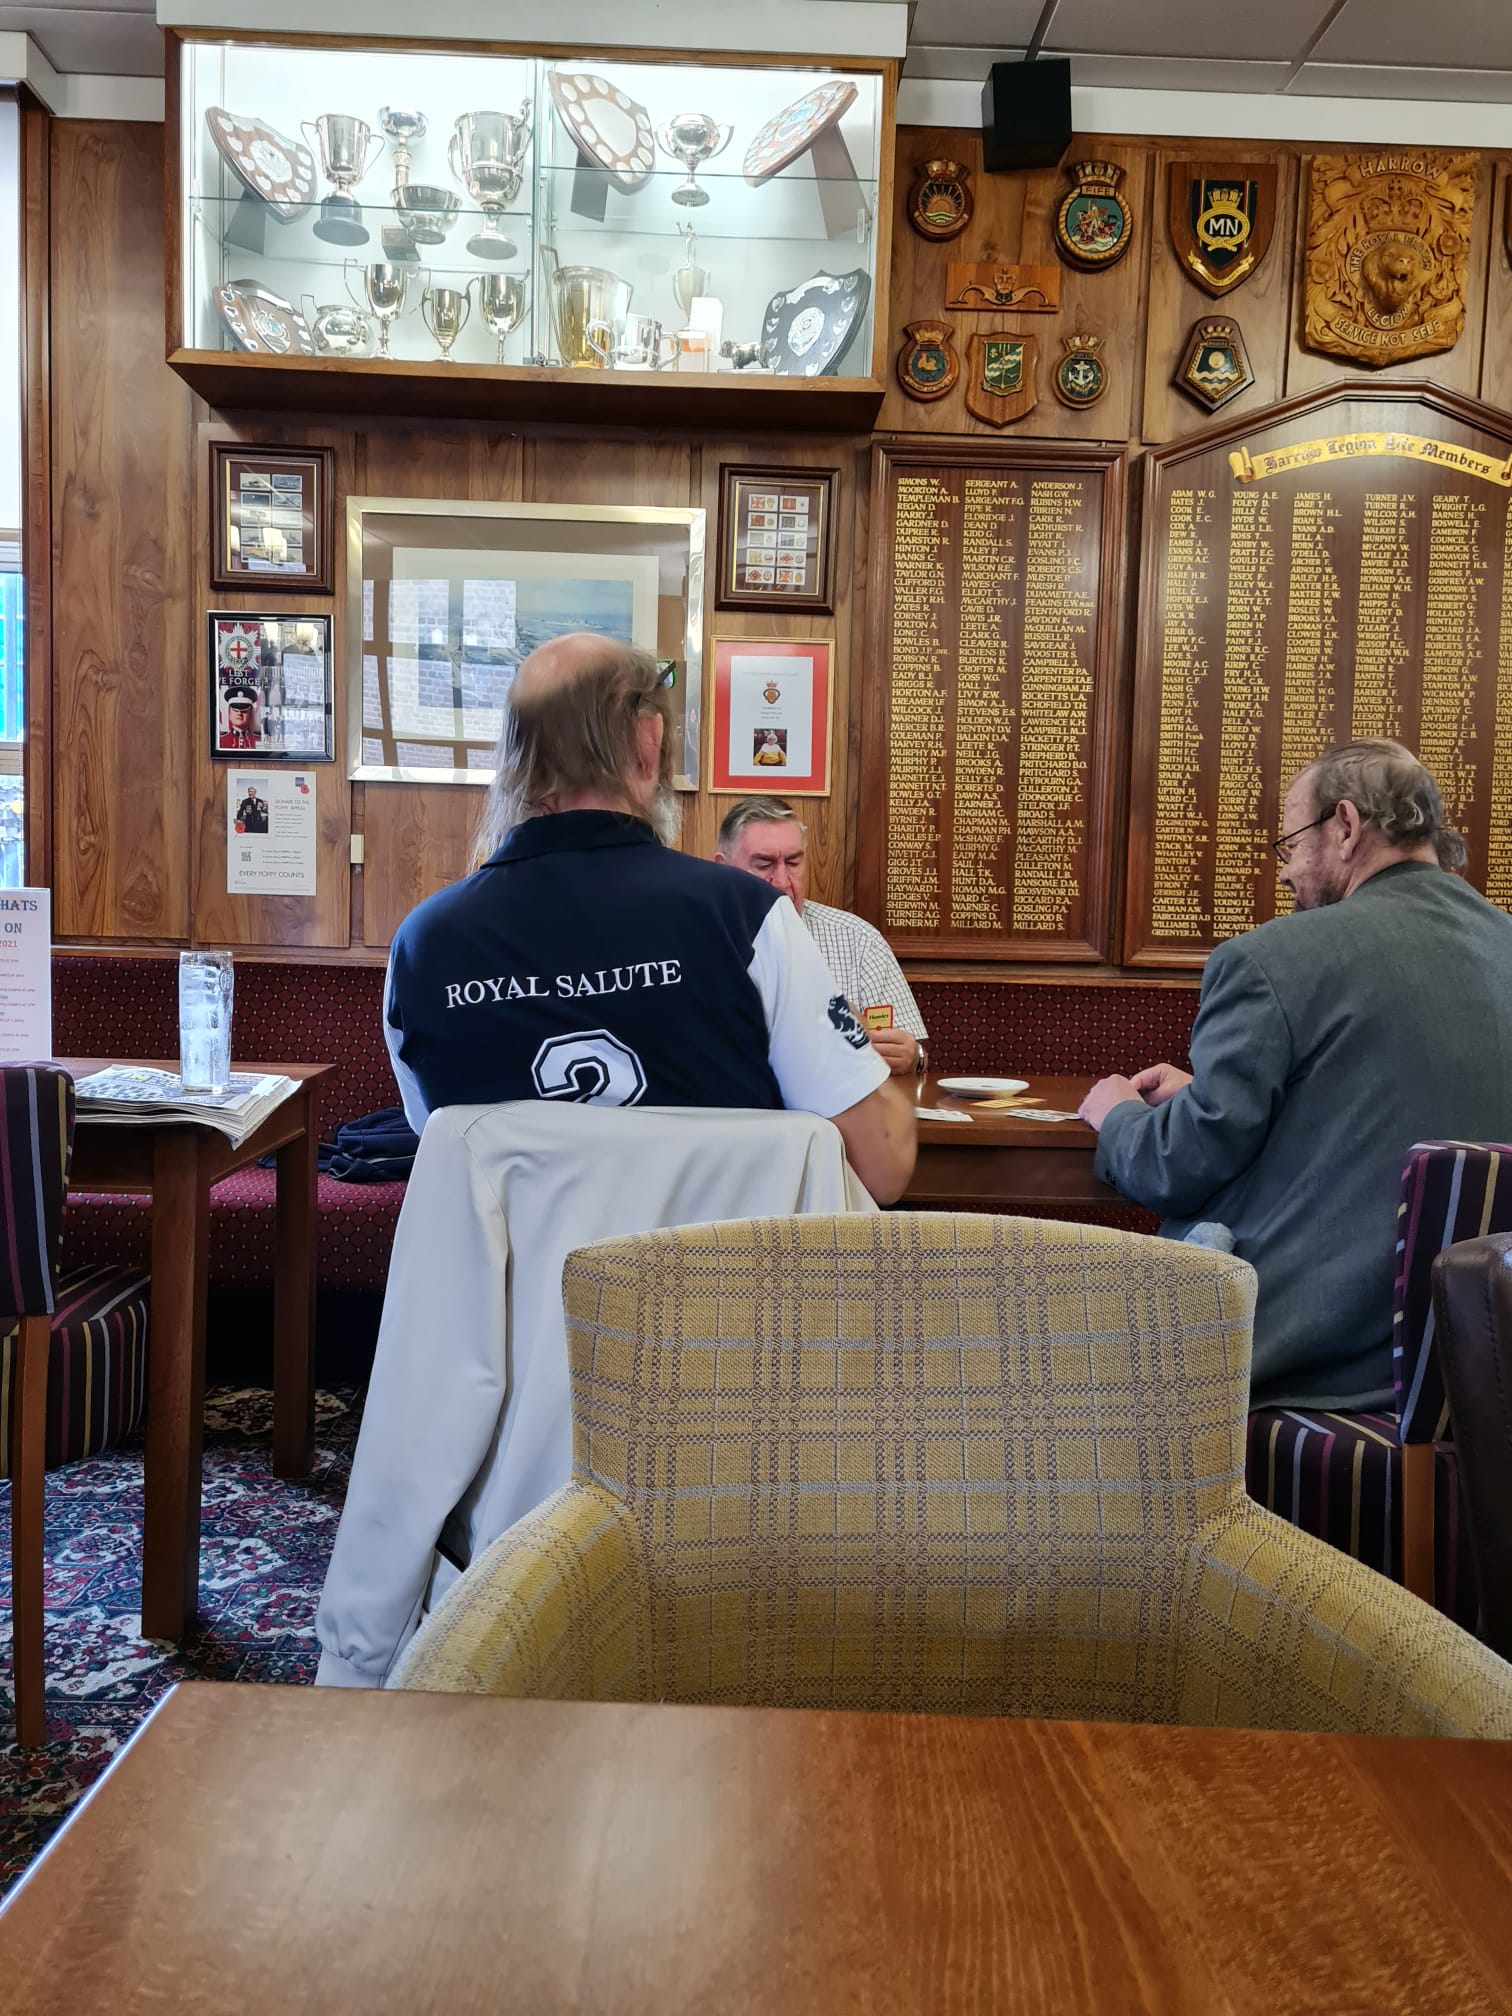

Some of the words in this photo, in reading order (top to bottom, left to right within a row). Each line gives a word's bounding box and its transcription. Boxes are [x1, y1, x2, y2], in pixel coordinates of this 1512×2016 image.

[1359, 157, 1441, 179] HARROW
[1209, 217, 1239, 235] MN
[1350, 248, 1363, 274] THE
[1335, 318, 1378, 344] SERVICE
[1380, 333, 1407, 347] NOT
[1412, 320, 1441, 341] SELF
[1419, 442, 1492, 475] Members
[898, 494, 950, 502] TEMPLEMAN
[962, 571, 1011, 579] MARCHANT
[959, 639, 999, 647] CLEAVER
[892, 688, 931, 696] HORTON
[1022, 691, 1068, 700] RICKETTS
[891, 723, 927, 731] MERCER
[1020, 734, 1060, 742] HACKETT
[1020, 743, 1064, 751] STRINGER
[1019, 768, 1070, 776] PRITCHARD
[954, 783, 993, 791] ROBERTS
[888, 824, 926, 832] CHARITY
[887, 884, 932, 892] HAYWARD
[0, 898, 38, 911] HATS
[886, 901, 927, 909] SHERWIN
[4, 922, 22, 933] ON
[445, 976, 550, 1008] ROYAL
[556, 960, 682, 998] SALUTE
